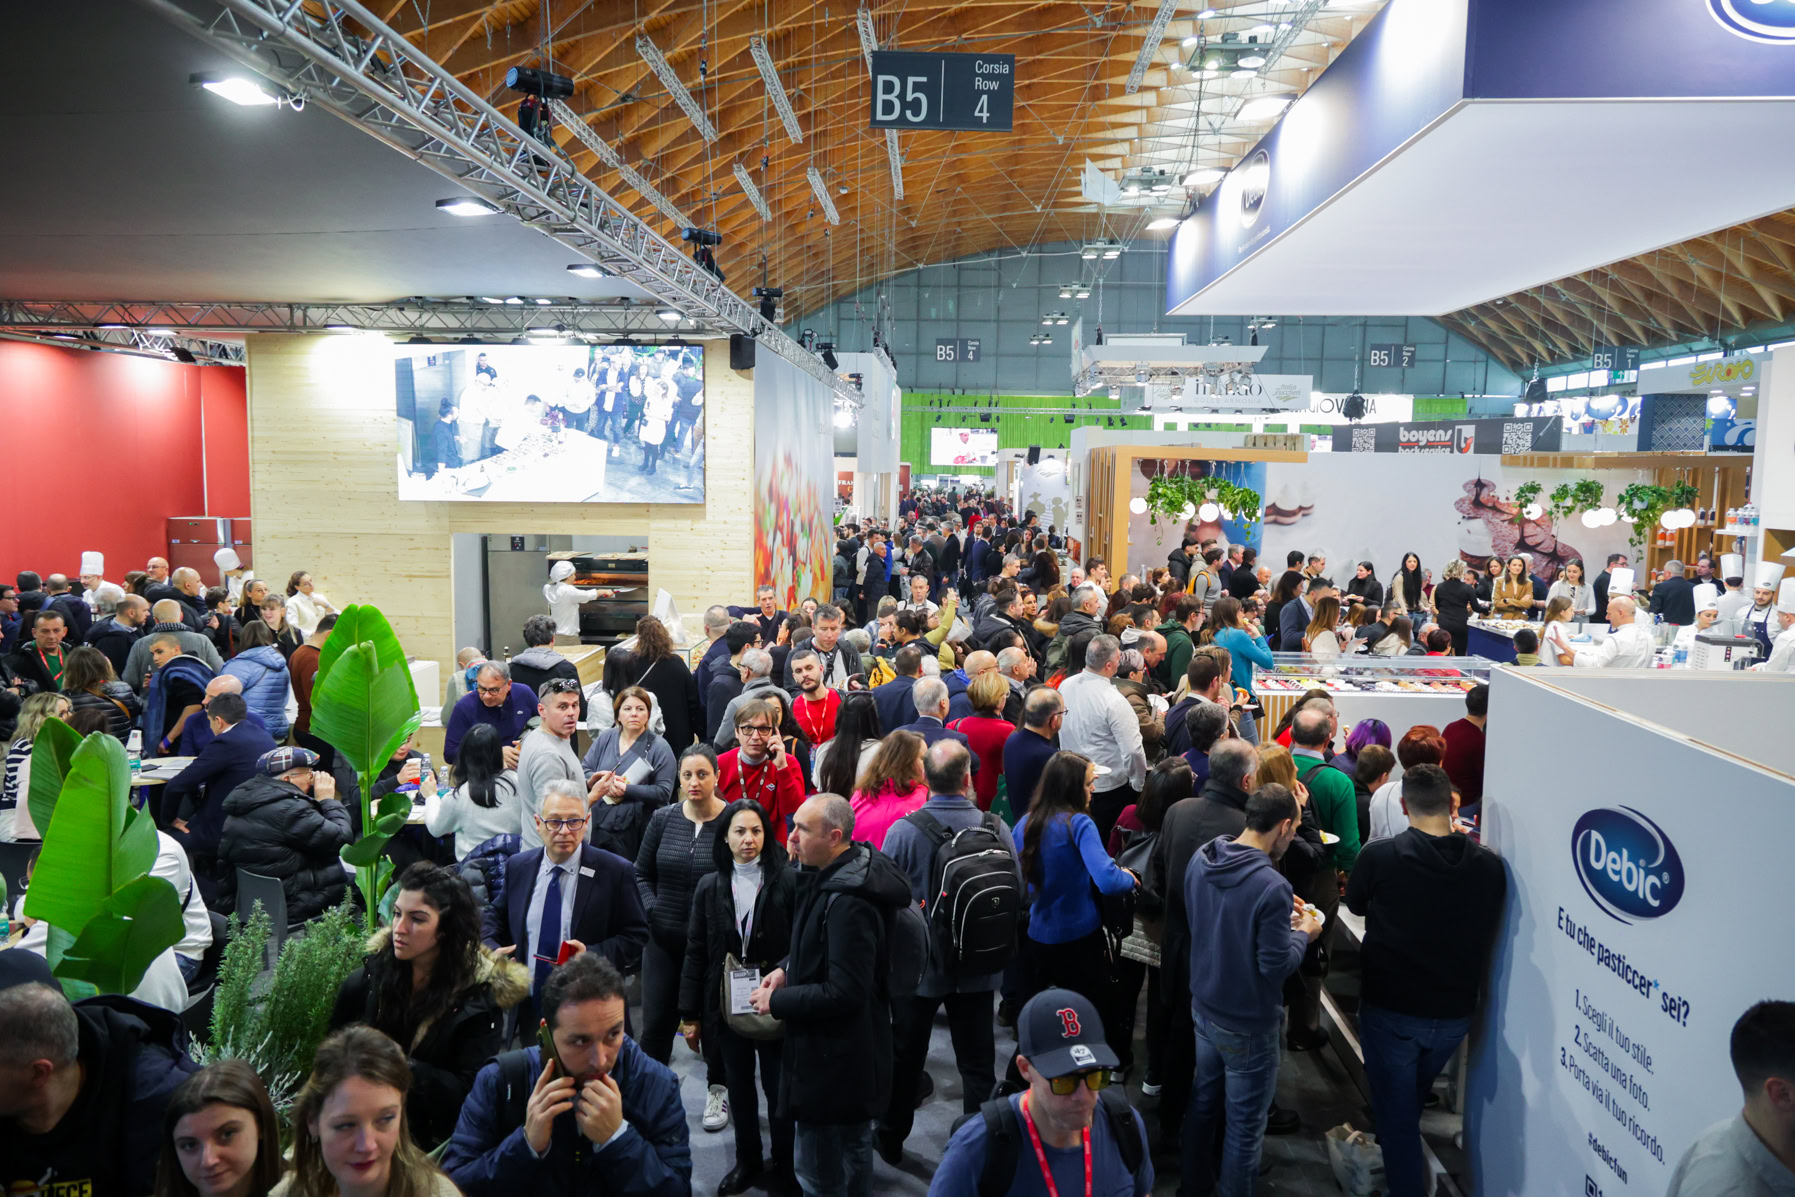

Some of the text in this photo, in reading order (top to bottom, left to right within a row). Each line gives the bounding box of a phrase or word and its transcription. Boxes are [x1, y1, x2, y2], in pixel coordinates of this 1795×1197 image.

[975, 60, 1009, 74] Corsia
[975, 77, 999, 91] Row
[876, 75, 928, 122] B5
[974, 94, 990, 124] 4
[937, 345, 954, 361] B5
[967, 350, 974, 361] 4
[1370, 350, 1388, 366] B5
[1402, 356, 1409, 367] 2
[1594, 353, 1612, 369] B5
[1627, 358, 1632, 369] 1
[1399, 427, 1453, 446] boyens
[1589, 828, 1661, 908] Debic
[1557, 906, 1564, 930] E
[1565, 914, 1576, 940] tu
[1577, 925, 1596, 956] che
[1661, 992, 1690, 1028] sei?
[1056, 1008, 1081, 1038] B
[1575, 988, 1654, 1075] 1. Scegli il tuo stile.
[1574, 1024, 1650, 1112] 2. Scatta una foto.
[1560, 1046, 1665, 1166] 3. Porta via il tuo ricordo.
[1587, 1131, 1628, 1185] #debicfun
